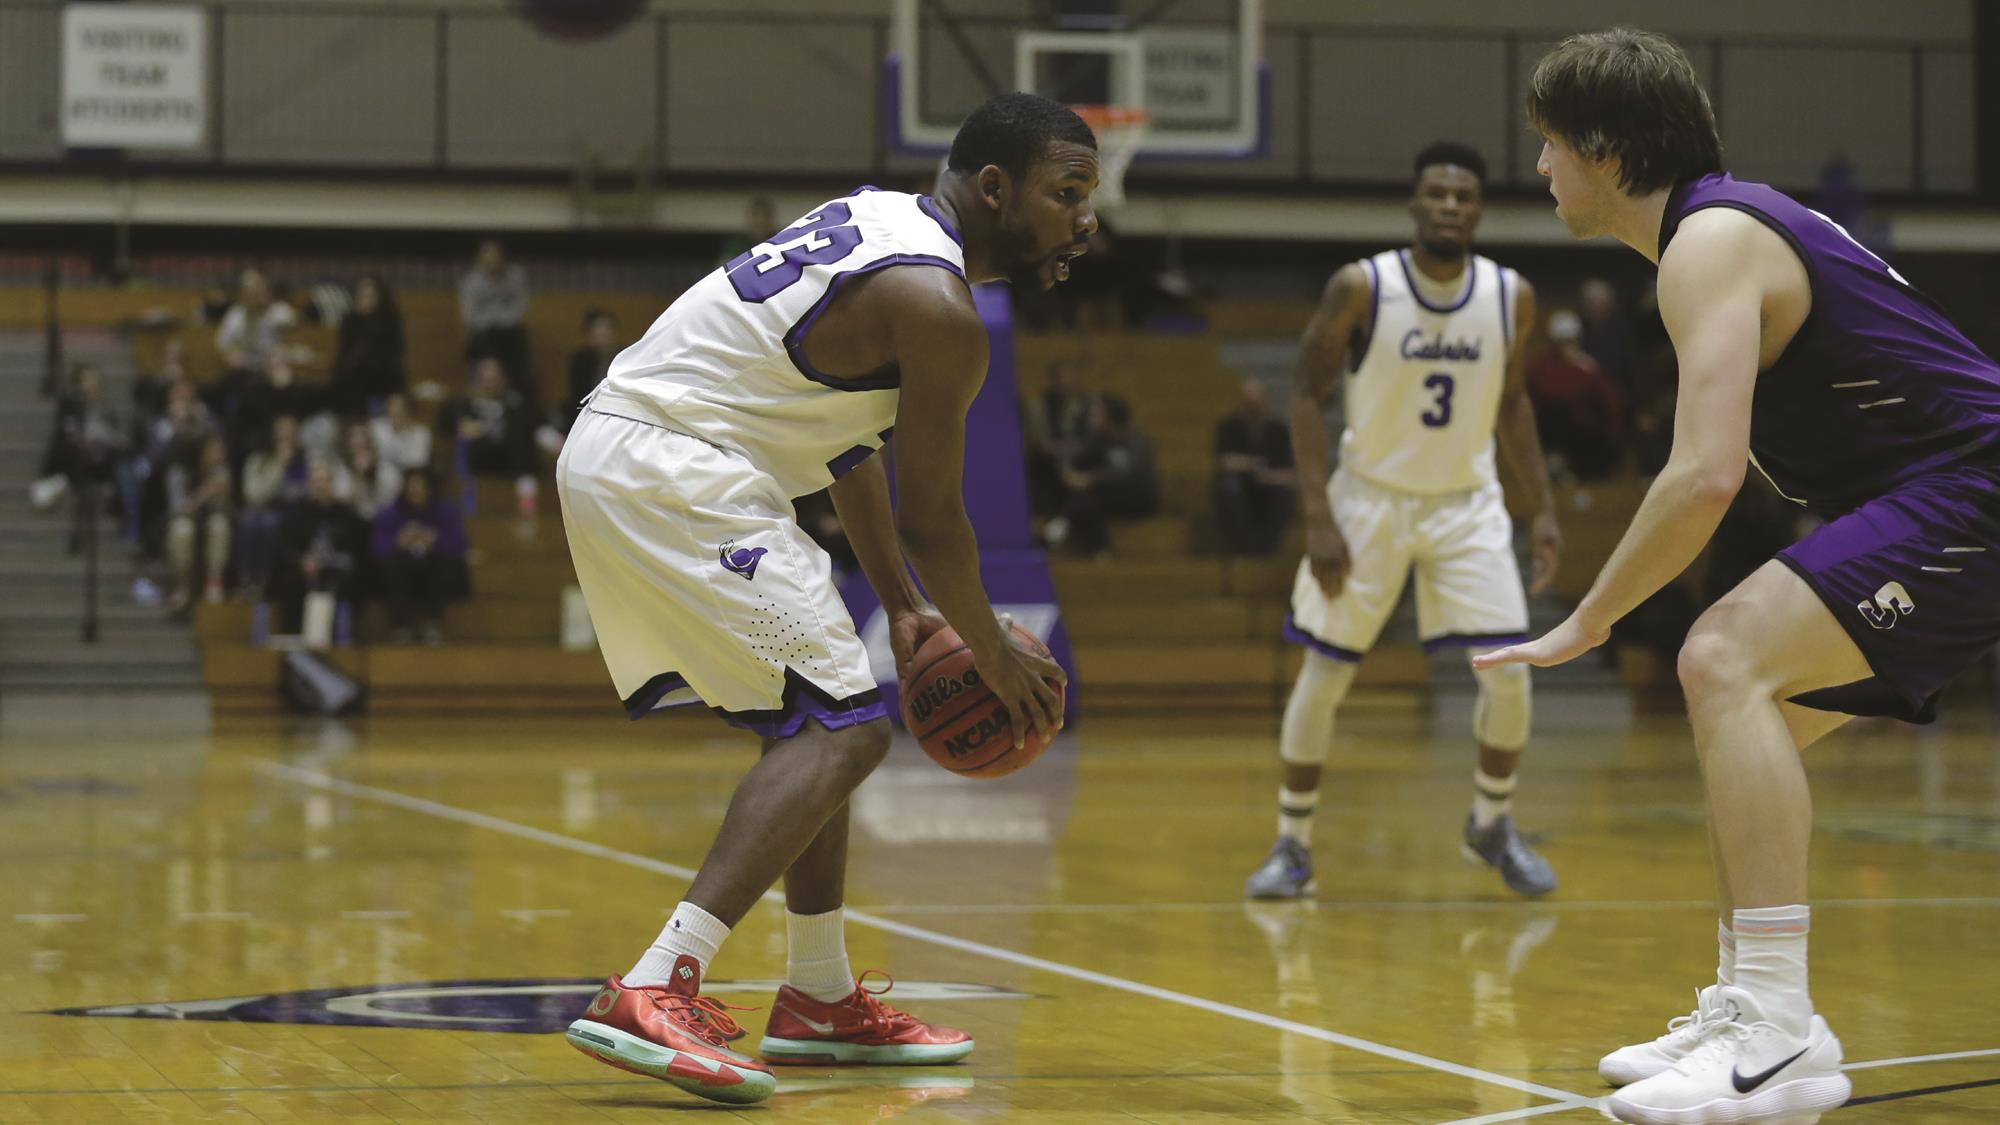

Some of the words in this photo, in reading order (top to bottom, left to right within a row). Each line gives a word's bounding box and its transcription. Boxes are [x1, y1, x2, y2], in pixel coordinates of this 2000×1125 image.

[723, 202, 864, 304] 23
[1399, 329, 1483, 361] Cabrini
[1421, 374, 1455, 427] 3
[911, 666, 982, 723] Wilso
